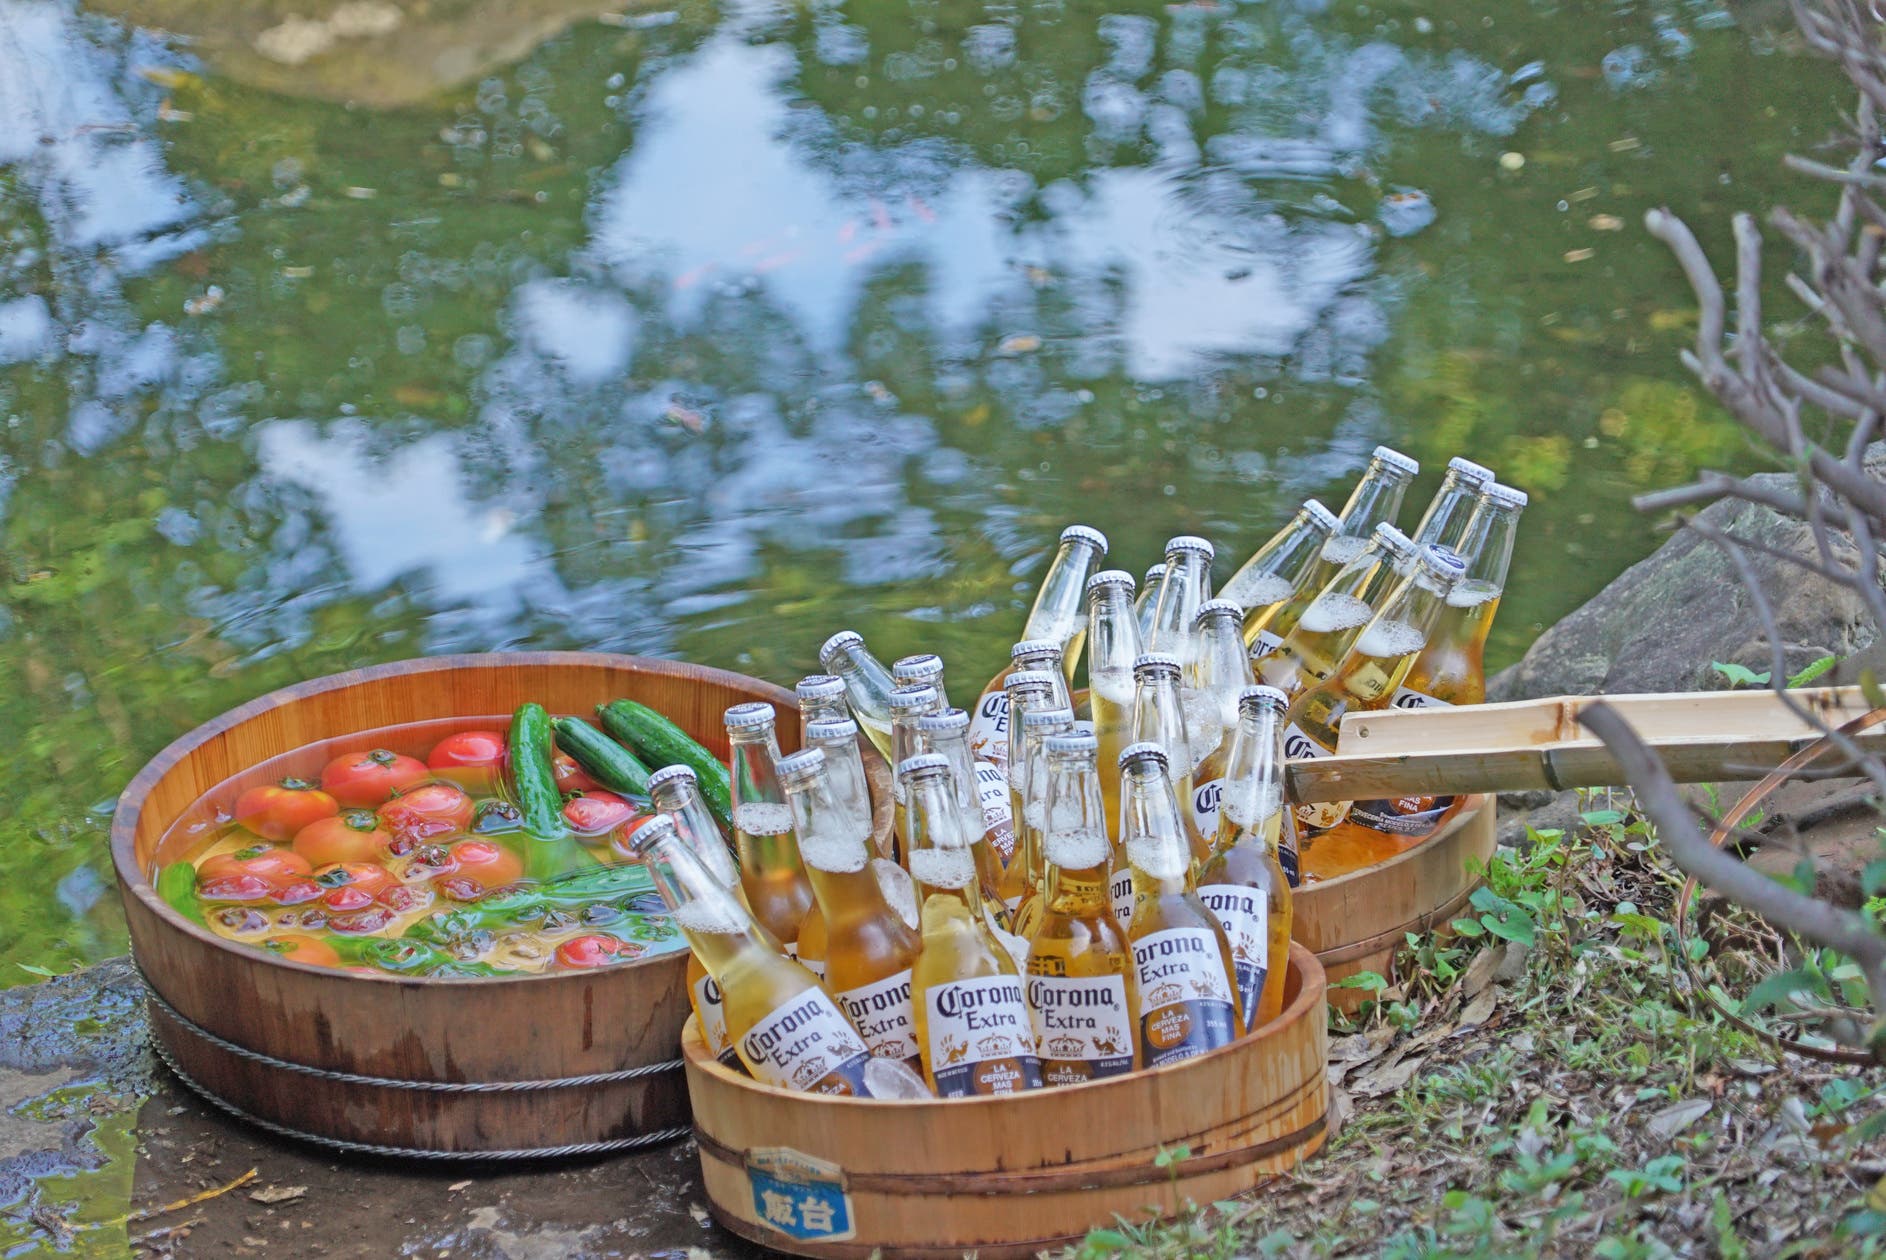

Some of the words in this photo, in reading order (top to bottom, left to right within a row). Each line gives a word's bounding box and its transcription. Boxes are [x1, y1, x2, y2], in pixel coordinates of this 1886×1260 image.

[1398, 800, 1418, 812] FINA
[1200, 893, 1255, 915] rona
[1134, 936, 1205, 965] orona
[1140, 961, 1190, 985] Extra
[936, 984, 1023, 1019] Corona
[1028, 980, 1114, 1014] Corona
[966, 1011, 1016, 1031] Extra
[1044, 1009, 1096, 1029] Extra
[1151, 1013, 1190, 1032] CERVEZA
[1161, 1009, 1174, 1019] LA
[743, 1000, 825, 1066] Corona
[857, 1015, 908, 1038] Extra
[1162, 1023, 1180, 1034] MAS
[1162, 1031, 1182, 1043] FINA
[771, 1031, 823, 1069] Extra
[980, 1071, 1020, 1083] CERVEZA
[993, 1064, 1007, 1073] LA
[1047, 1073, 1088, 1082] CERVEZA
[1059, 1066, 1072, 1074] LA
[992, 1080, 1013, 1089] MAS
